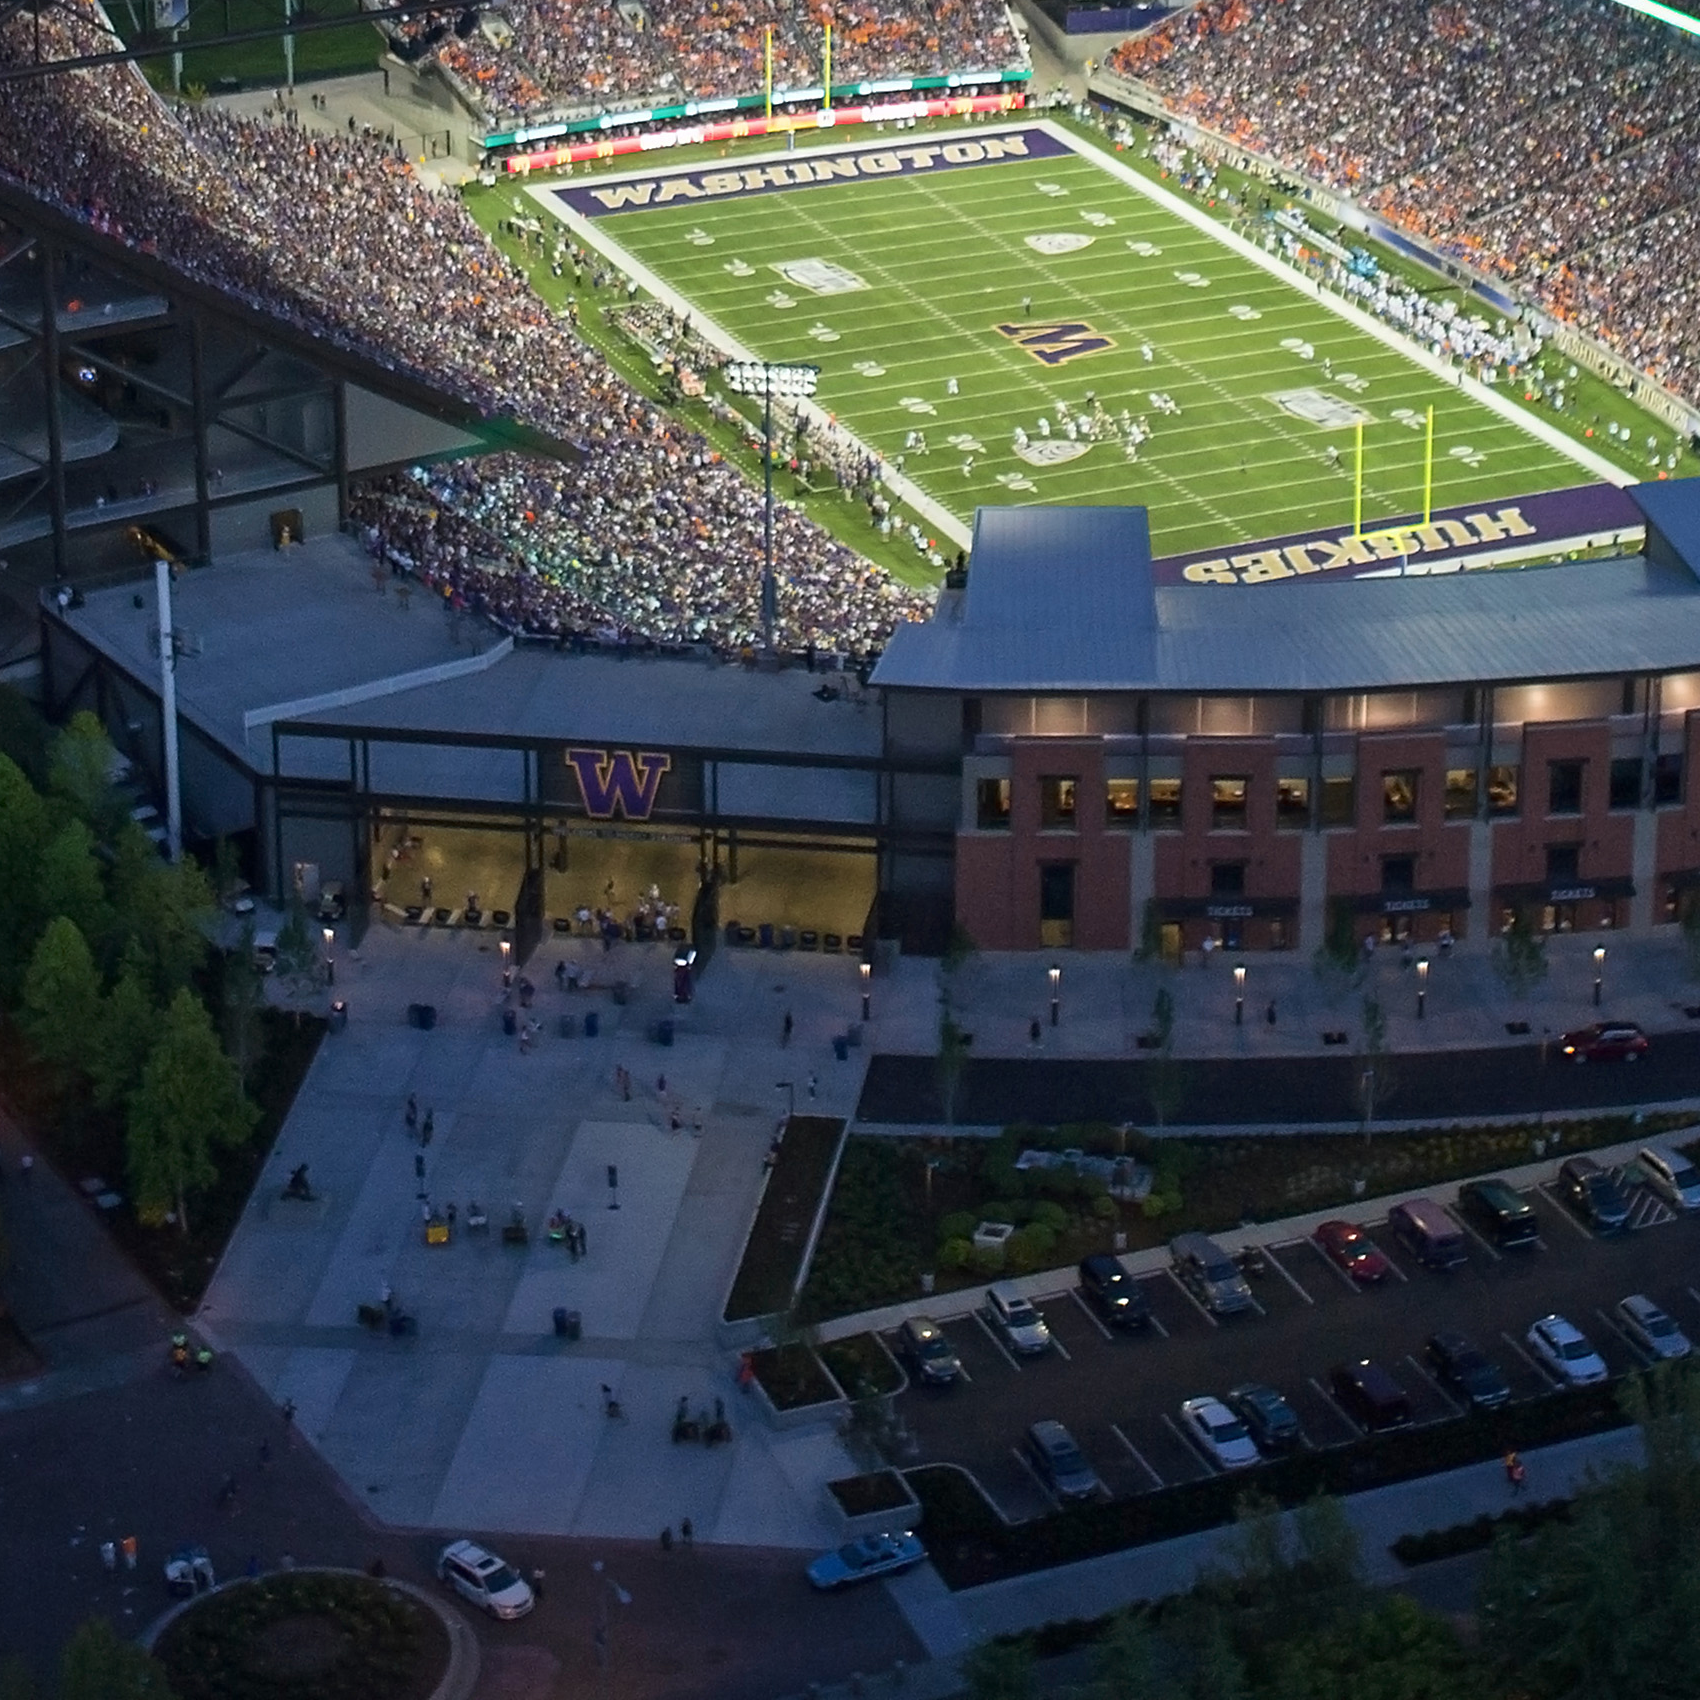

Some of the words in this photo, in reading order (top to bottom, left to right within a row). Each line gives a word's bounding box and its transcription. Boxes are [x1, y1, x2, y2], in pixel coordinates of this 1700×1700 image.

[592, 136, 1029, 209] WASHINGTON
[990, 321, 1118, 368] W
[1183, 507, 1536, 585] HUSKIES
[565, 747, 672, 820] W
[1207, 905, 1254, 918] TICKETS
[1550, 886, 1597, 901] TICKETS
